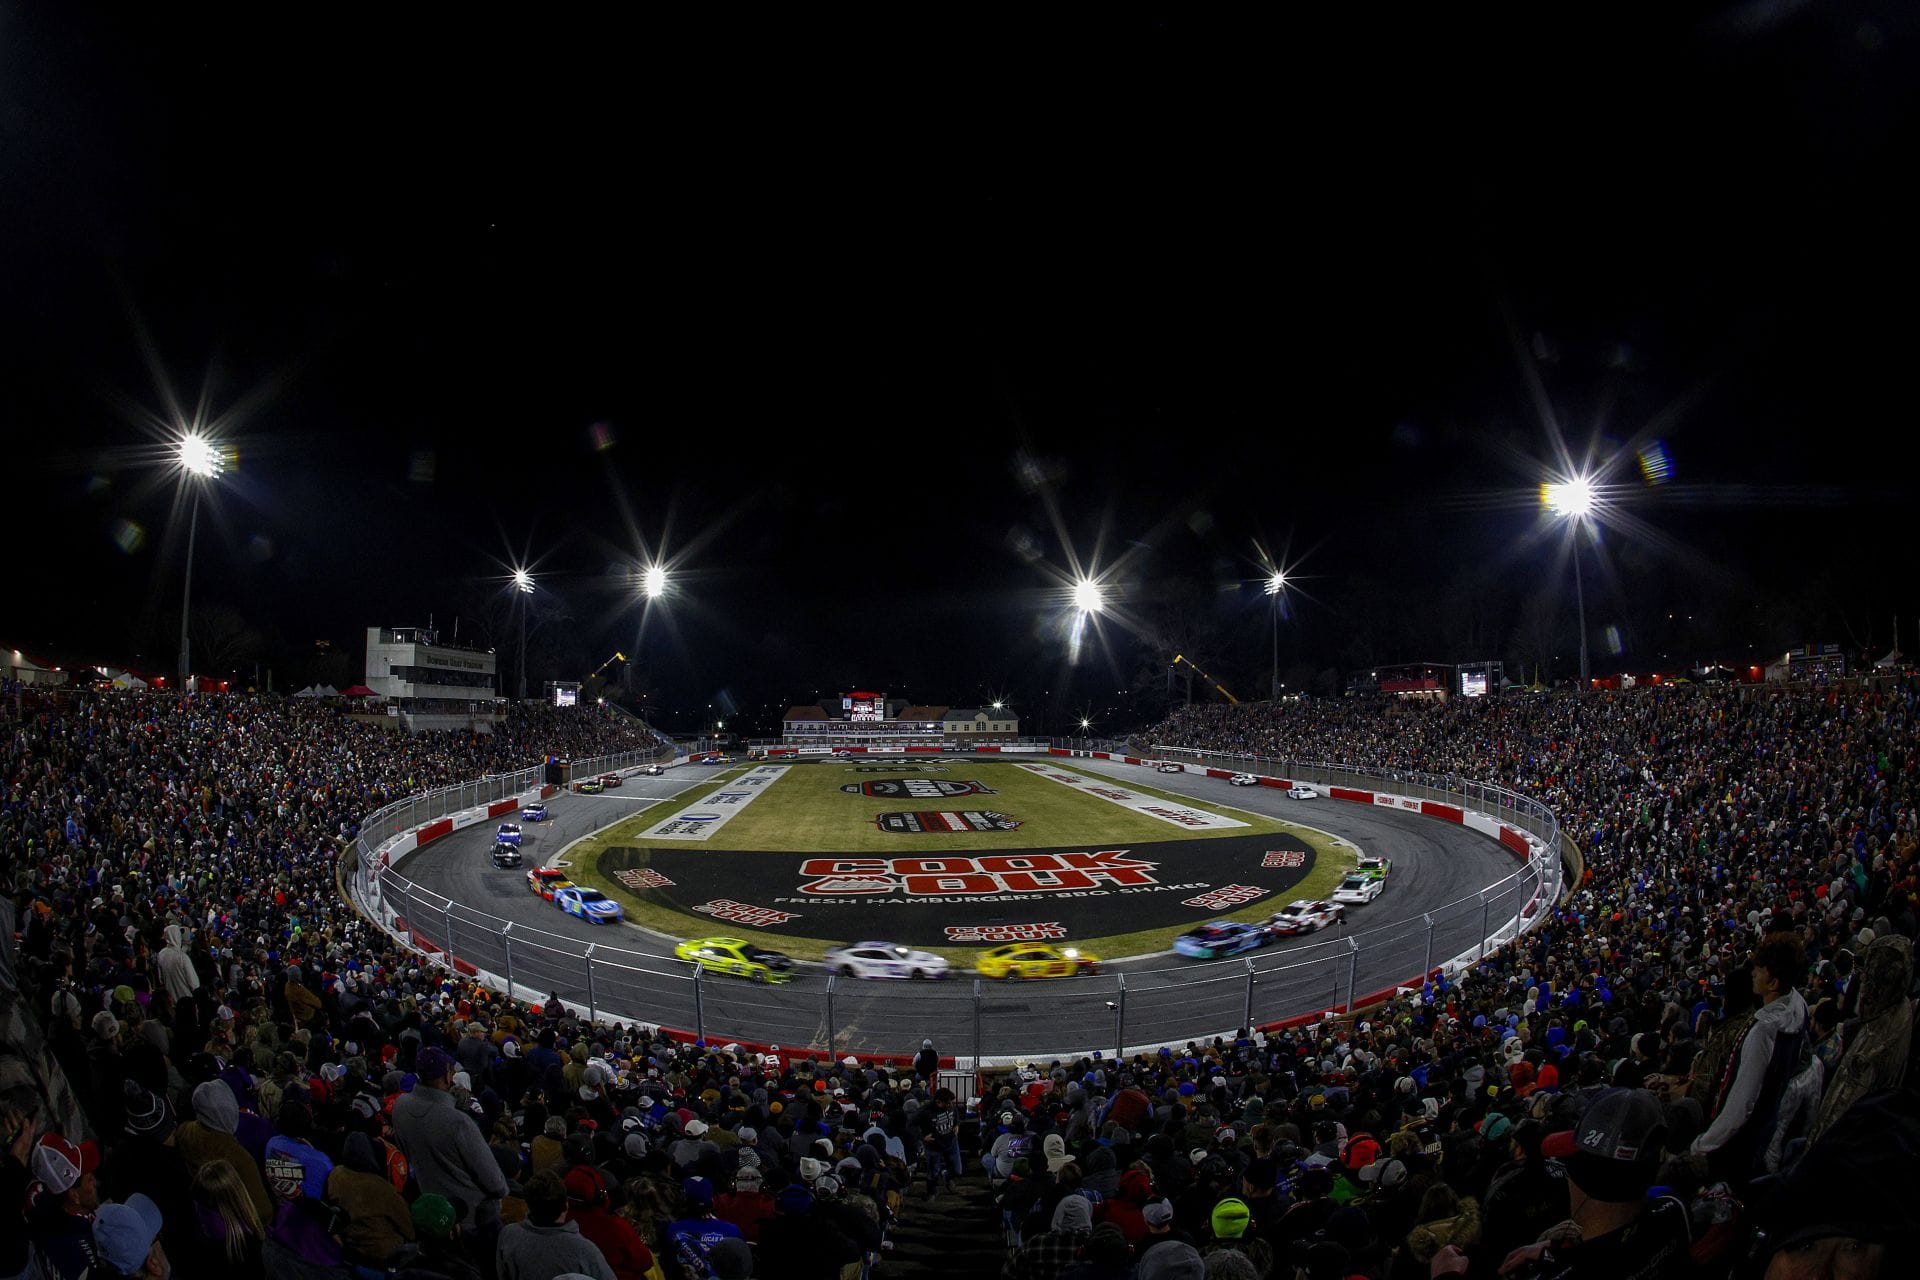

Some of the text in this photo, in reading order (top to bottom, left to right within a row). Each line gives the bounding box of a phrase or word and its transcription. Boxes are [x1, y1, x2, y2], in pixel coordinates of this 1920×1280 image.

[799, 850, 1161, 876] COOK
[902, 865, 1160, 895] OUT
[867, 893, 1043, 904] HAMBURGERS
[1055, 890, 1110, 899] BBQ
[1119, 882, 1211, 894] SHAKES
[1181, 884, 1246, 906] COOK
[1226, 886, 1271, 904] OUT
[706, 900, 803, 921] COOK
[710, 909, 789, 926] OUT
[944, 921, 1064, 934] COOK
[983, 929, 1067, 941] OUT
[1583, 1129, 1605, 1147] 24
